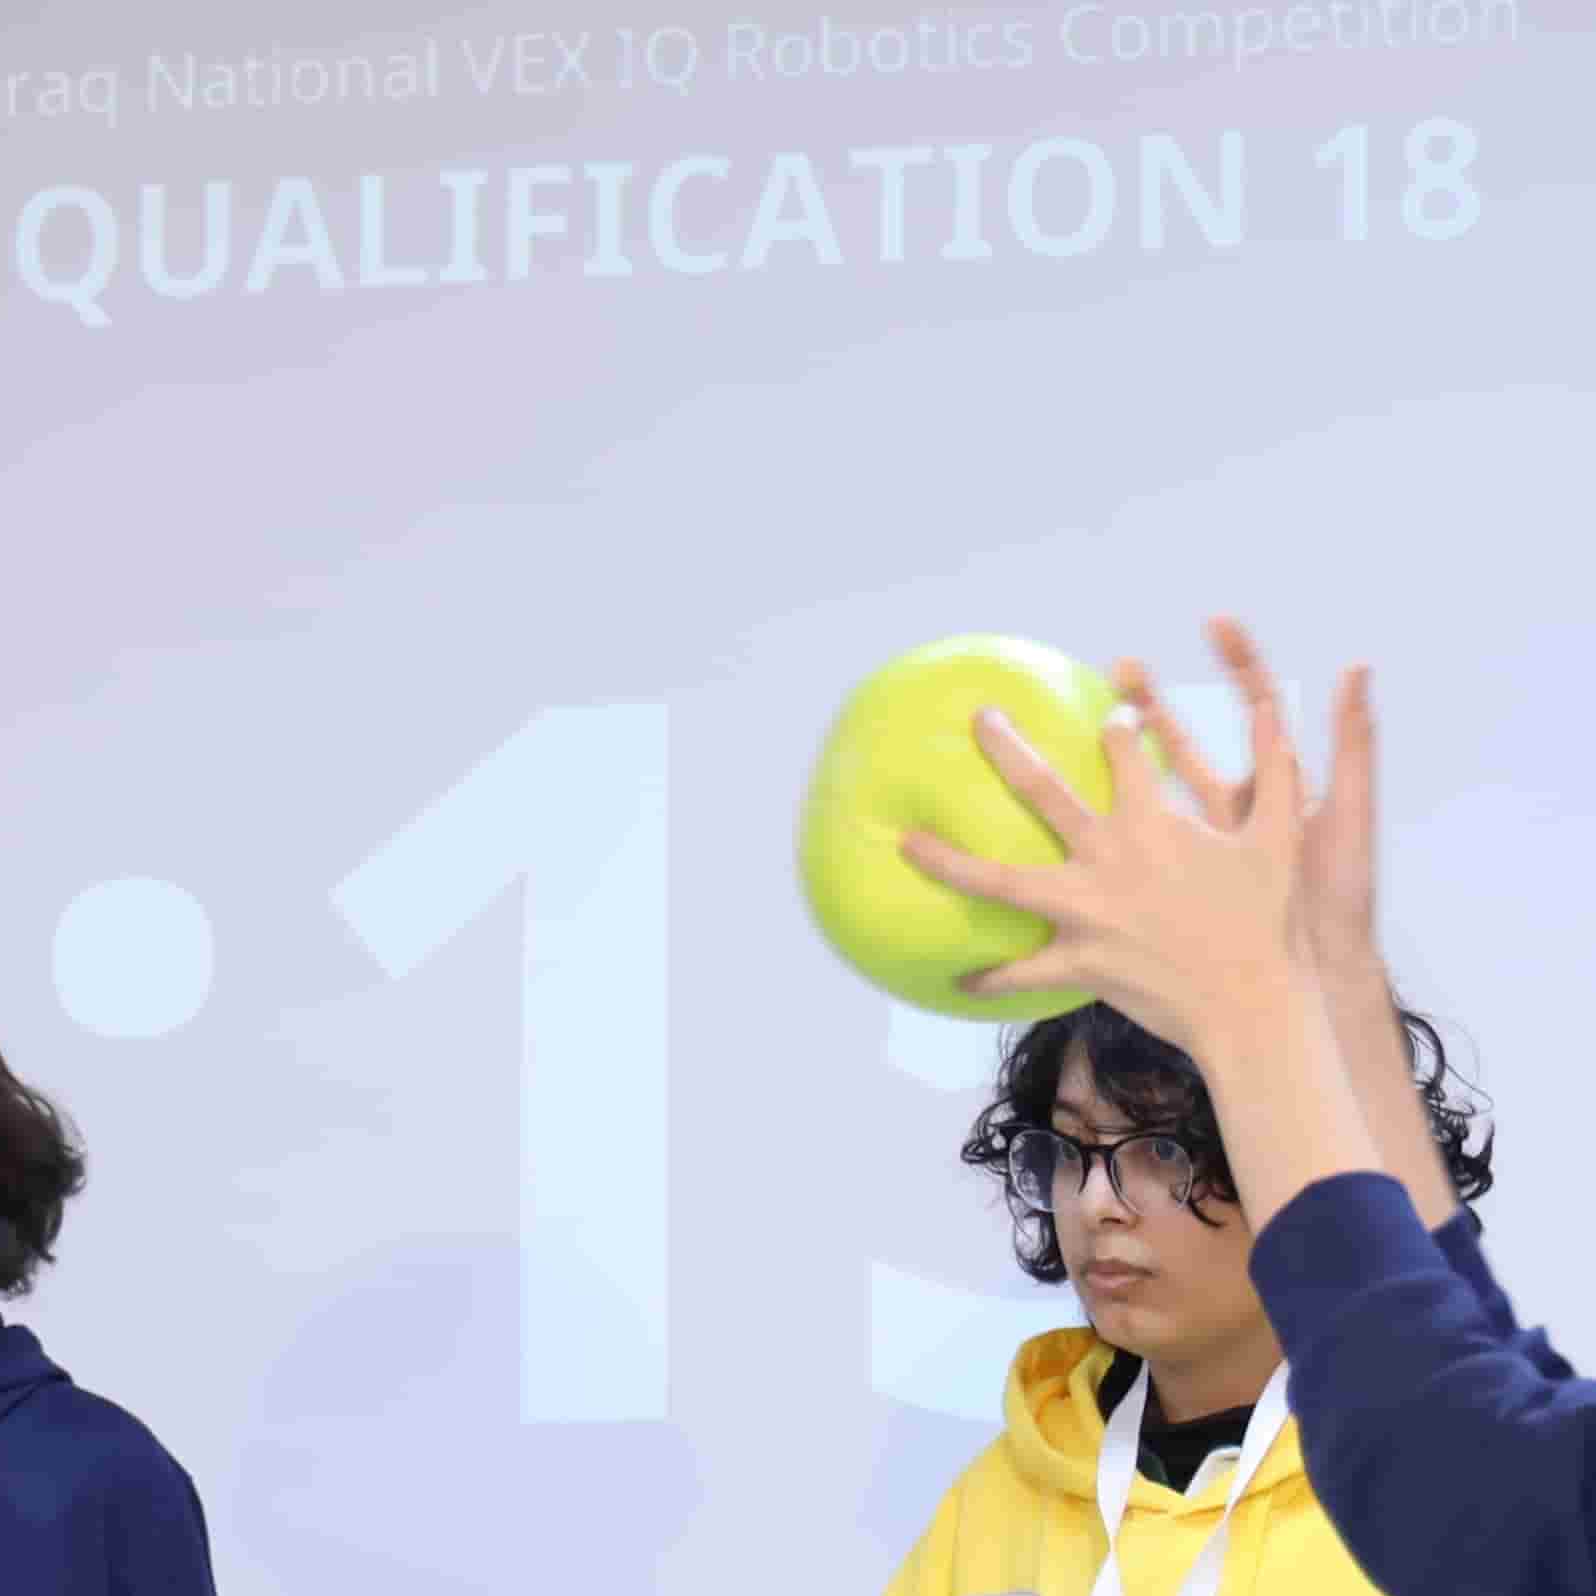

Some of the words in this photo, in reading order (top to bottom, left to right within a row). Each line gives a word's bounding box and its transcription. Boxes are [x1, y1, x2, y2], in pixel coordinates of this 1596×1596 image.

[146, 34, 441, 113] National
[461, 30, 595, 97] VEX
[614, 24, 702, 97] IQ
[726, 14, 1035, 80] Robotics
[1059, 0, 1524, 73] Competition
[13, 129, 1250, 329] QUALIFICATION
[1313, 114, 1483, 242] 18
